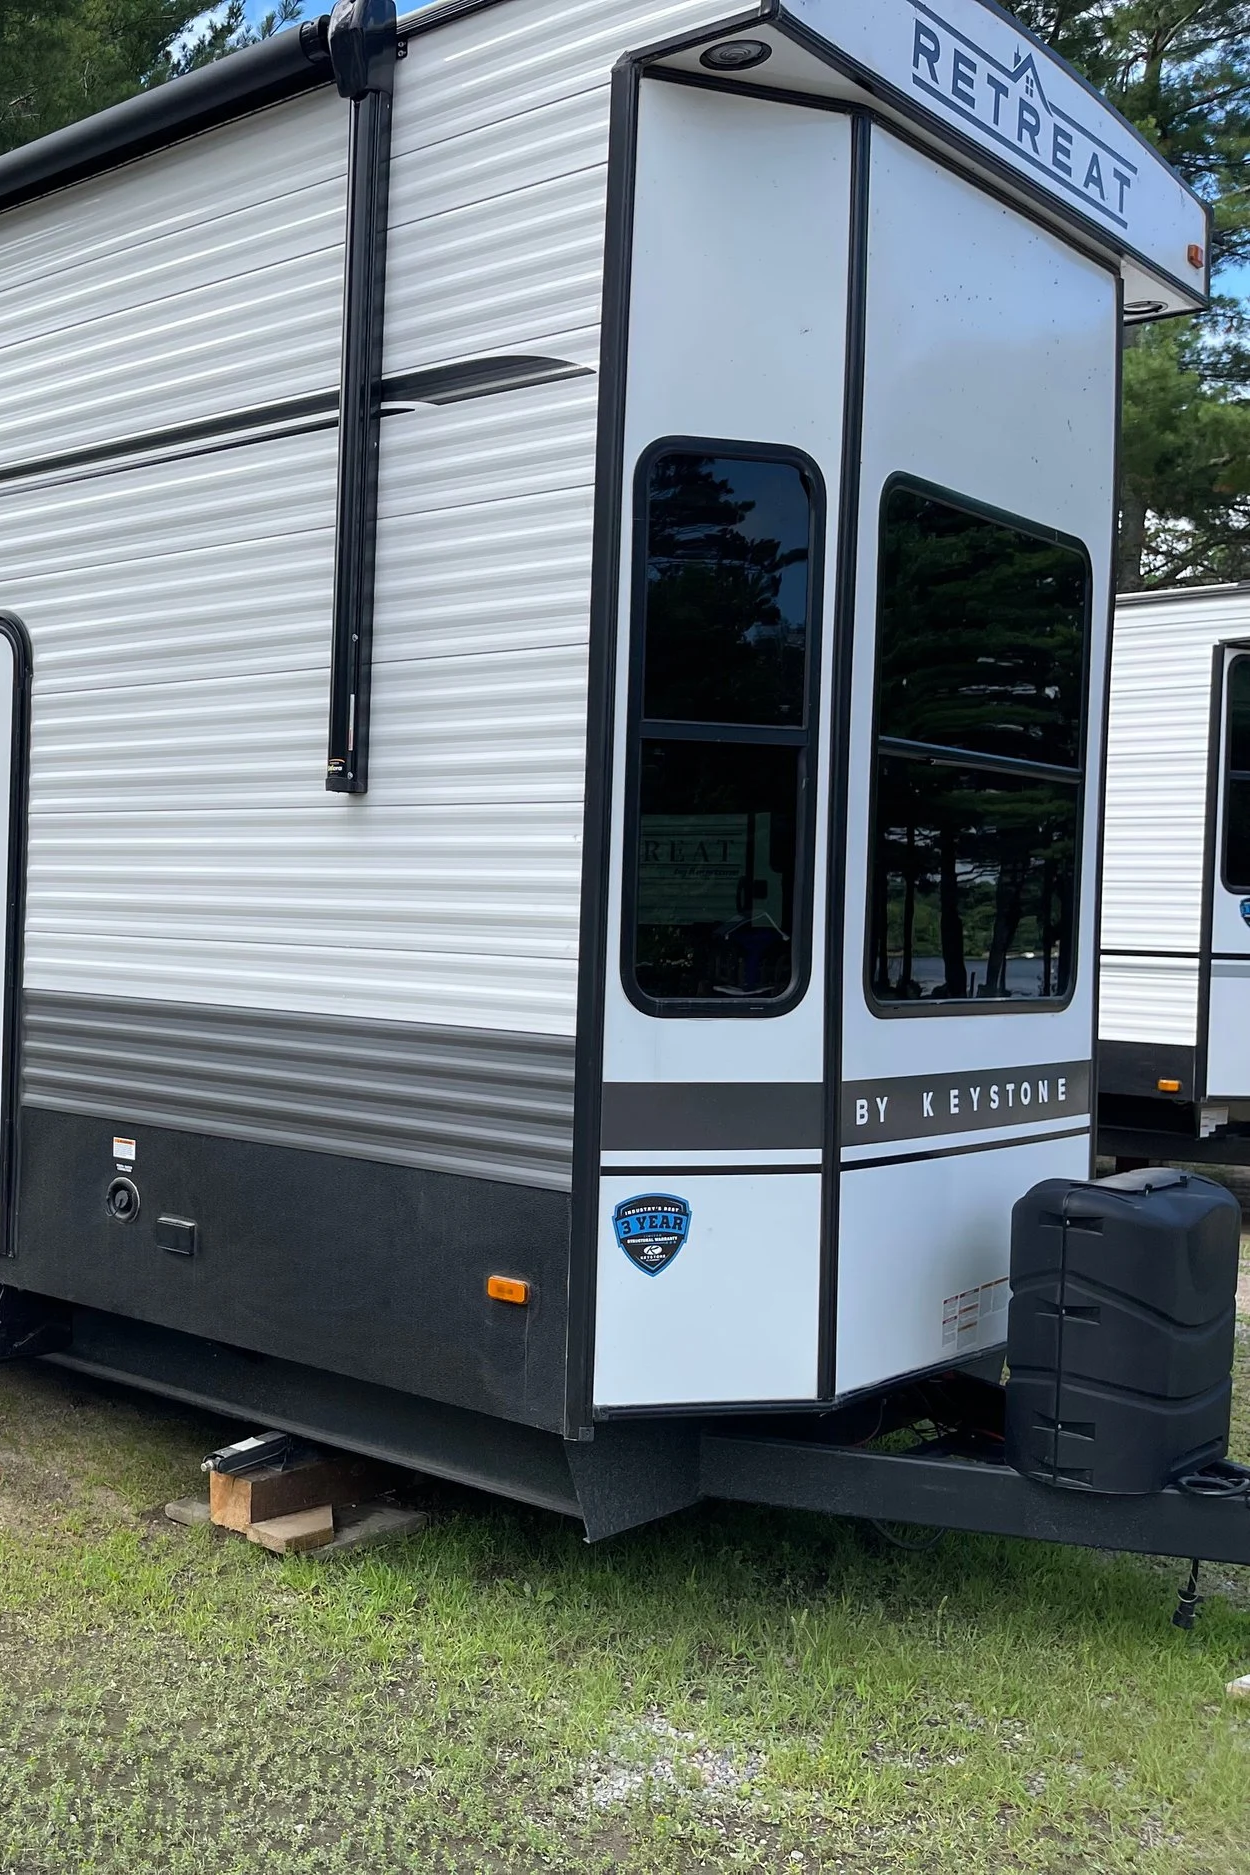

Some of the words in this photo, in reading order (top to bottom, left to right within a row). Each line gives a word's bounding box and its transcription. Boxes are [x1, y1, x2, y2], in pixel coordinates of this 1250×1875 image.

[912, 18, 1132, 214] RETREAT
[855, 1096, 888, 1126] BY
[922, 1077, 1066, 1118] KEYSTONE
[621, 1220, 631, 1235] 3
[636, 1215, 683, 1231] YEAR
[624, 1206, 662, 1216] INDUSTRY'S
